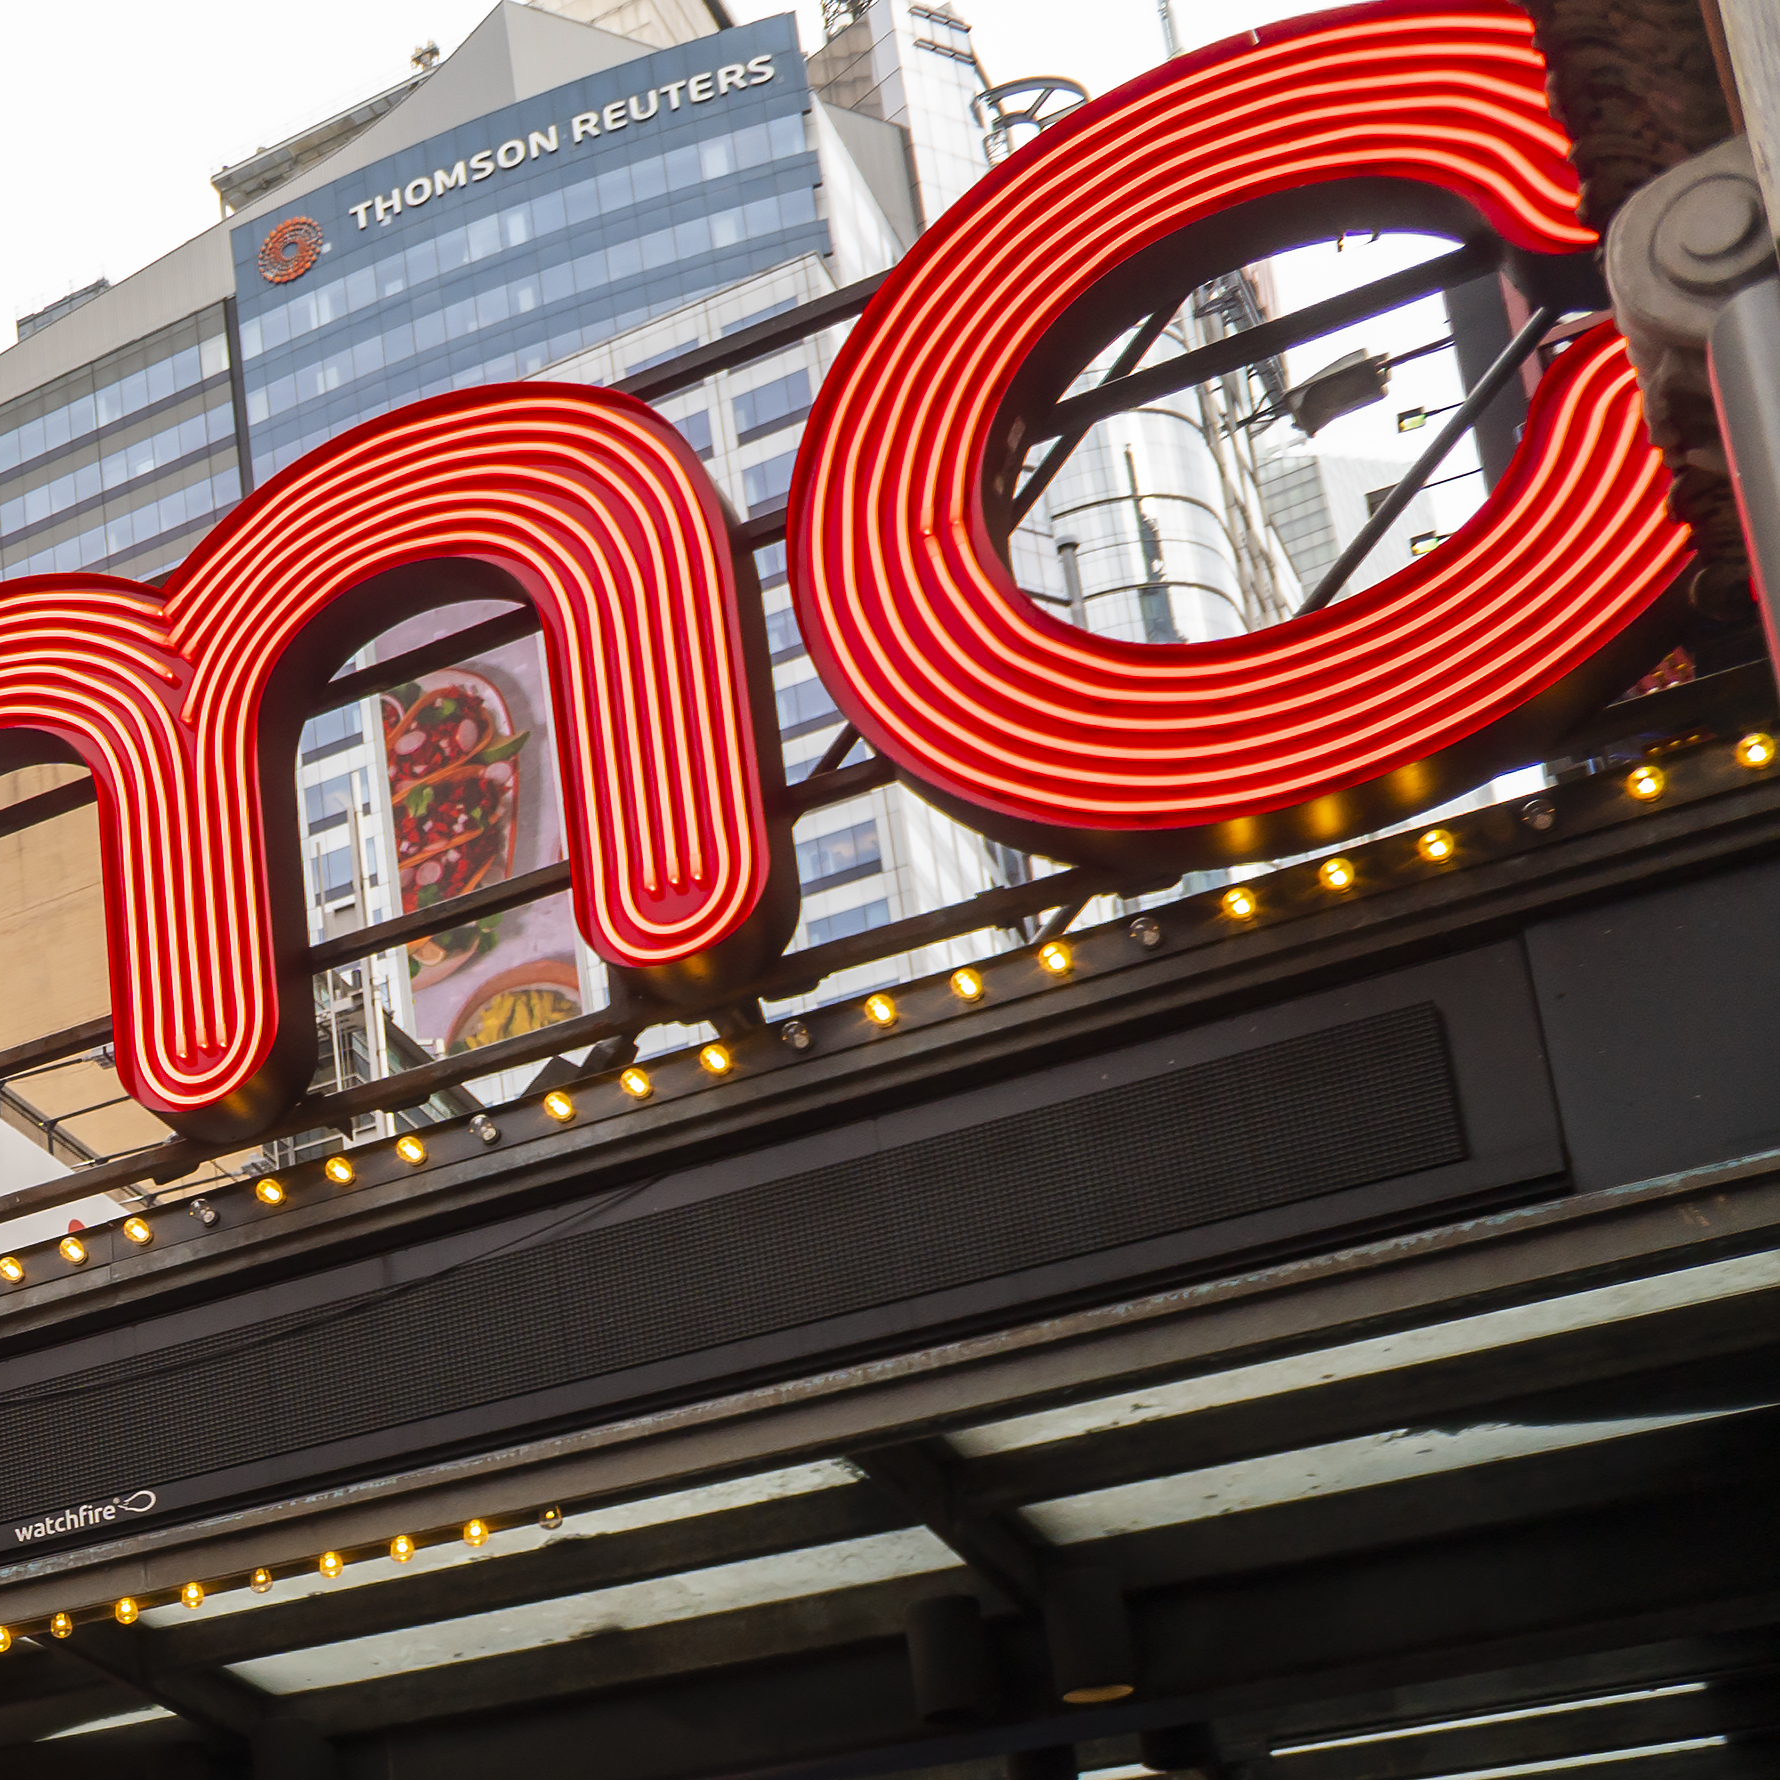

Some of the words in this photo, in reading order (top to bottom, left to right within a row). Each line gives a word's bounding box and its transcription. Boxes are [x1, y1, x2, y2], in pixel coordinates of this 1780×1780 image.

[348, 125, 559, 231] THOMSON
[571, 54, 777, 145] REUTERS
[14, 1504, 117, 1543] watchfire
